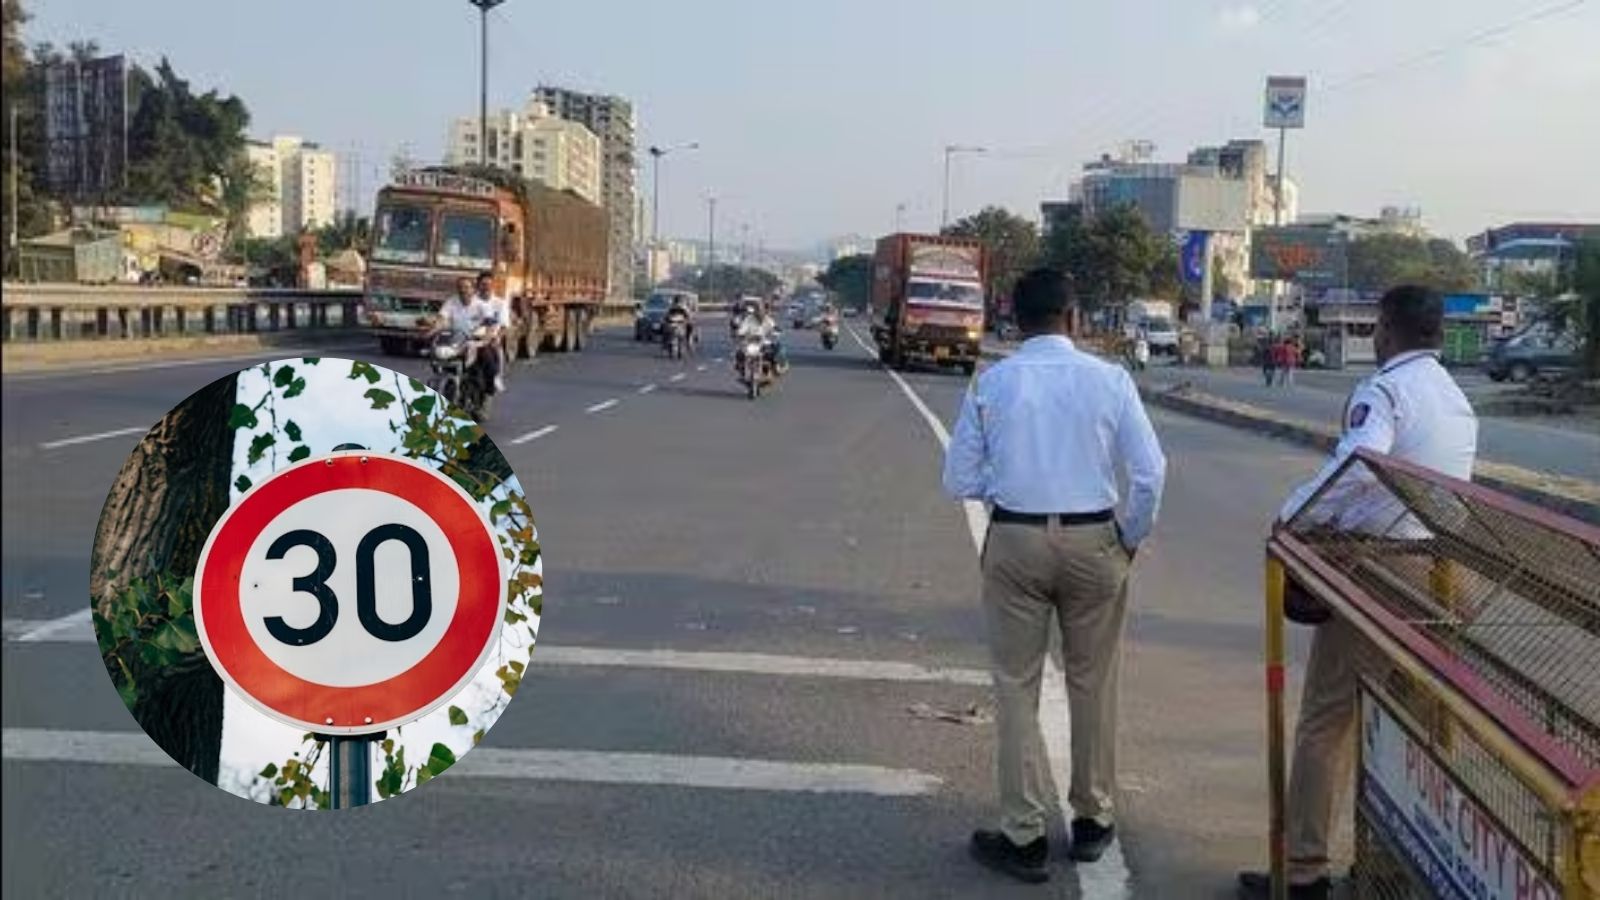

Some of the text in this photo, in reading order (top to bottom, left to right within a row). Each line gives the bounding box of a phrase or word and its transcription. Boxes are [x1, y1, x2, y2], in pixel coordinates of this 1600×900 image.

[263, 523, 432, 646] 30
[1406, 738, 1453, 832] PUNE
[1458, 798, 1507, 889] CITY
